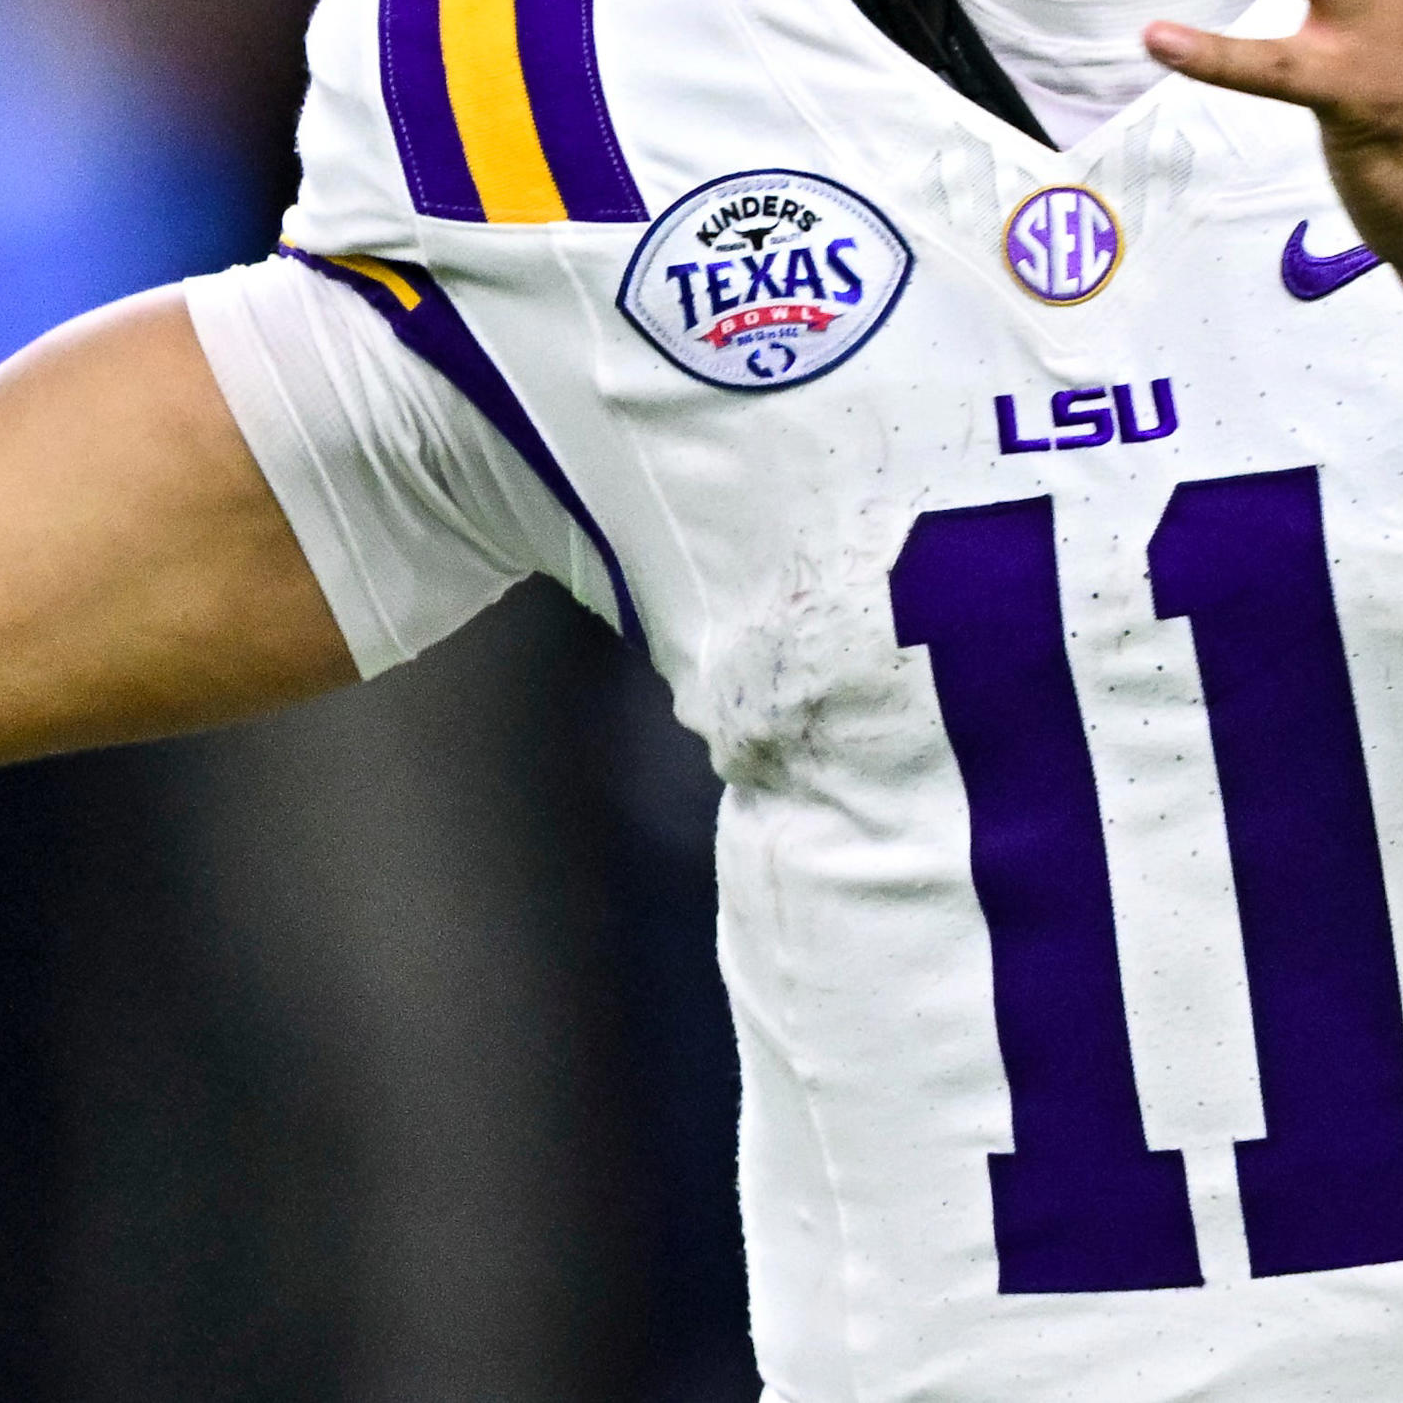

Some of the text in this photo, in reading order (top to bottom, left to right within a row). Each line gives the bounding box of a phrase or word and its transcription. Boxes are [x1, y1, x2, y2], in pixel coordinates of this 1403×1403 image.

[696, 195, 818, 247] KINDER'S
[1013, 191, 1113, 296] SEC
[665, 236, 864, 333] TEXAS
[721, 304, 814, 334] BOWL
[994, 377, 1179, 455] LSU
